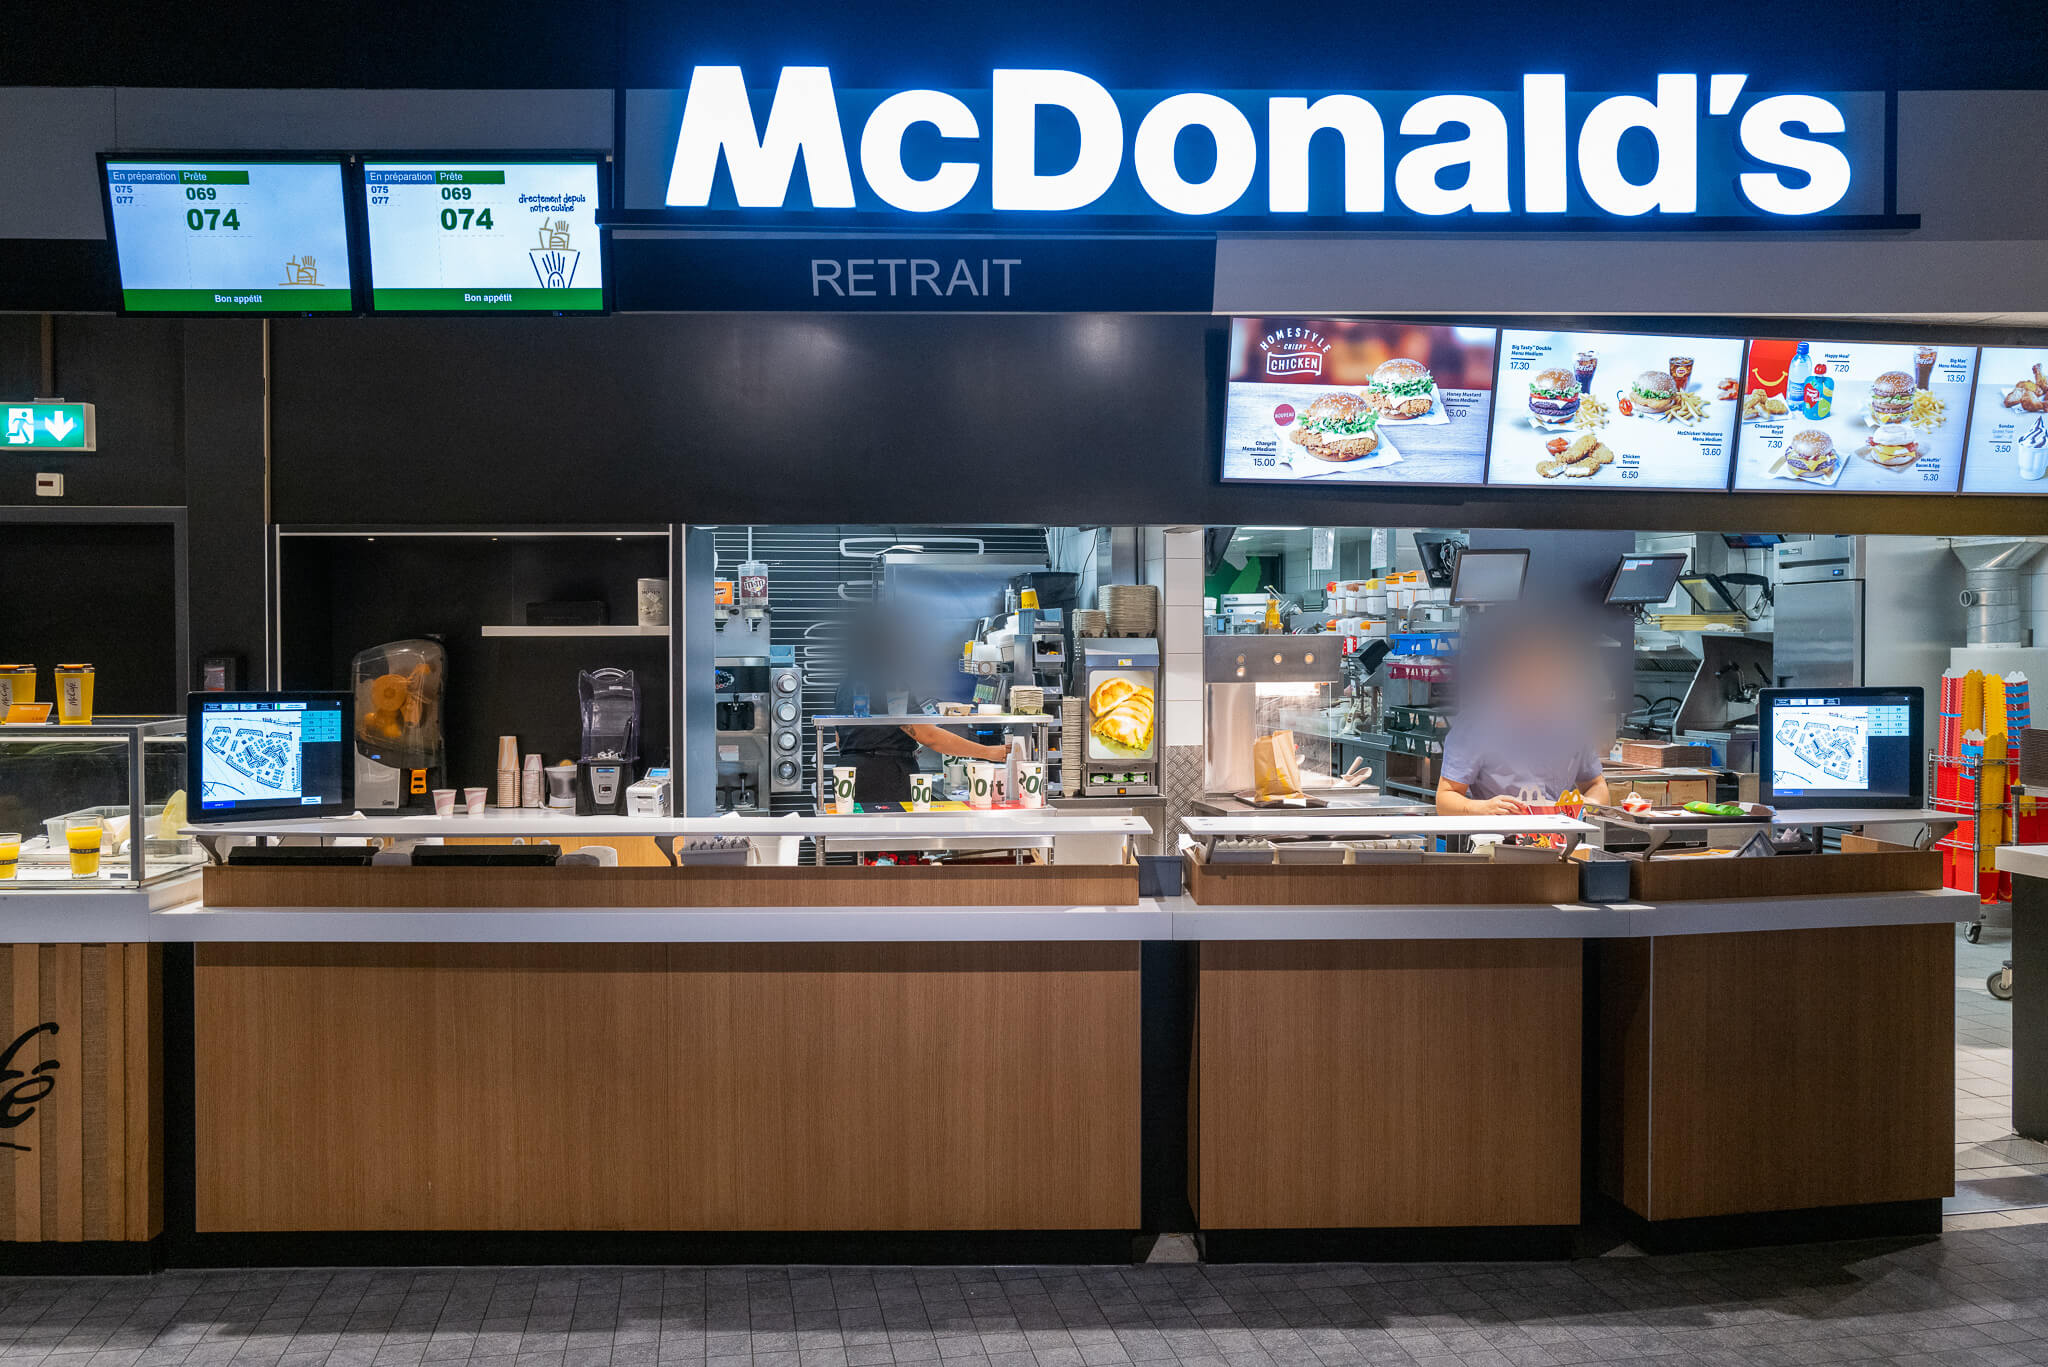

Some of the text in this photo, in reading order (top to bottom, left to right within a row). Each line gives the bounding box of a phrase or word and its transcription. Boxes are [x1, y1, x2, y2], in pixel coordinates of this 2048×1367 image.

[664, 65, 1853, 216] McDonald's
[113, 171, 207, 182] En préparation Prête
[370, 172, 463, 182] En préparation Prête
[114, 185, 133, 193] 075
[371, 185, 389, 194] 075
[186, 187, 216, 201] 069
[441, 187, 471, 201] 069
[116, 196, 134, 204] 077
[371, 196, 389, 204] 077
[518, 193, 586, 205] directement depuis
[530, 203, 575, 213] notre cuisine
[186, 208, 241, 231] 074
[441, 208, 494, 231] 074
[811, 258, 1022, 297] RETRAIT
[214, 294, 263, 305] Bon appétit
[464, 293, 513, 304] Bon appétit
[1260, 327, 1332, 353] HOMESTYLE
[1271, 357, 1318, 371] CHICKEN
[1510, 361, 1530, 370] 17.30
[1834, 364, 1850, 373] 7.20
[1947, 374, 1966, 383] 13.50
[1446, 409, 1467, 418] 15.00
[1767, 440, 1783, 448] 7.30
[1994, 444, 2011, 453] 3.50
[1701, 447, 1722, 456] 13.60
[1253, 458, 1276, 467] 15.00
[1621, 470, 1639, 479] 6.50
[1923, 473, 1939, 481] 5.30
